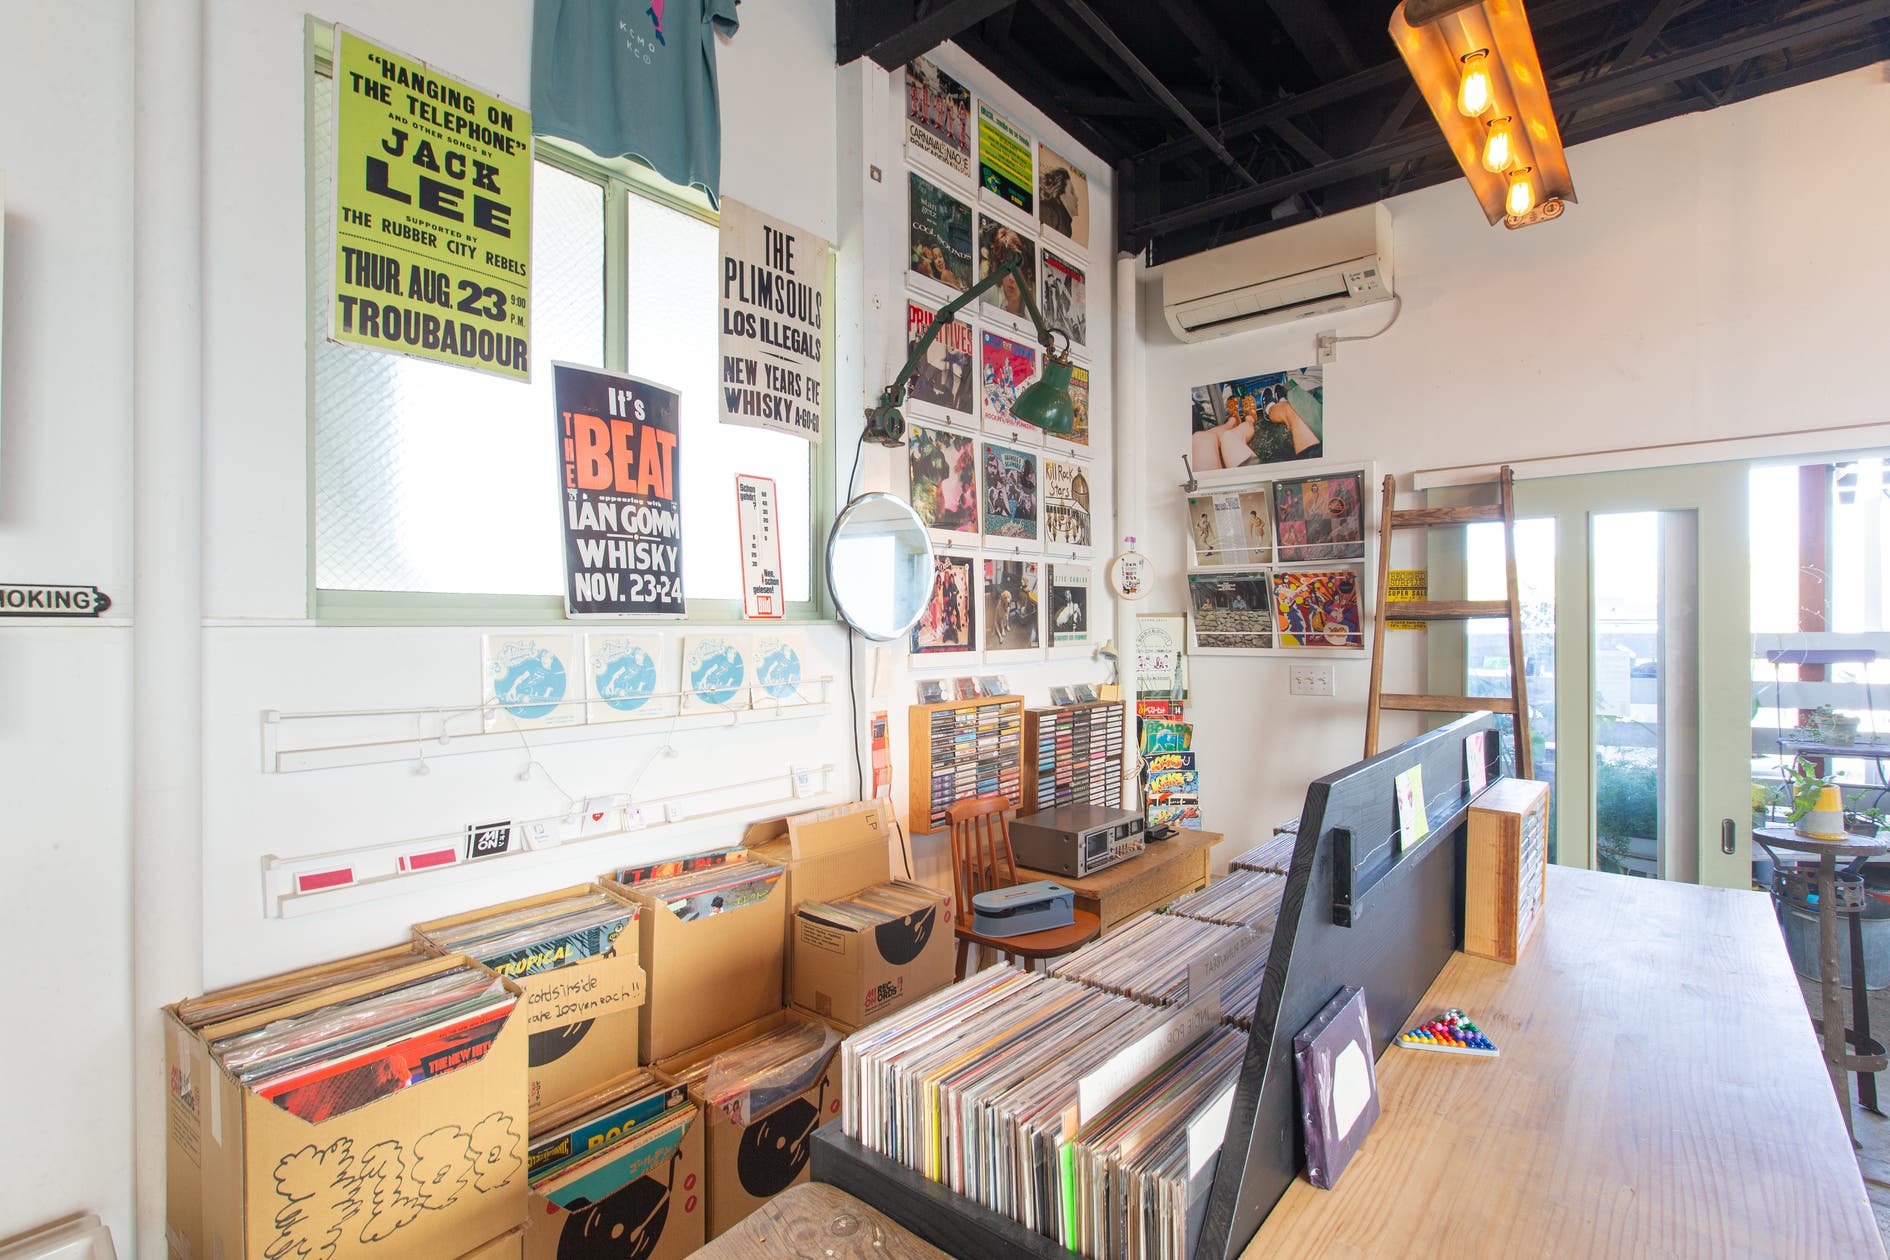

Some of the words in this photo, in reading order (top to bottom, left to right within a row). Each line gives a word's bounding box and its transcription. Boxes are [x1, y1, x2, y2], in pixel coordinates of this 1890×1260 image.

[350, 71, 392, 106] THE
[388, 112, 408, 125] AND
[412, 120, 442, 140] OTHER
[447, 136, 476, 154] SONGS
[481, 150, 493, 159] BY
[488, 106, 513, 132] ON
[382, 128, 500, 194] JACK
[366, 156, 511, 238] LEE
[342, 206, 372, 230] THE
[382, 218, 437, 248] RUBBER
[446, 238, 477, 260] CITY
[486, 252, 527, 278] REBELS
[406, 215, 462, 240] SUPPORTED
[466, 234, 478, 244] BY
[764, 224, 795, 275] THE
[342, 246, 404, 298] THUR.
[408, 265, 453, 310] AUG.
[724, 256, 822, 330] PLIMSOULS
[456, 280, 507, 322] 23
[510, 294, 526, 310] 9:00
[510, 312, 526, 328] P.M.
[338, 294, 528, 372] TROUBADOUR
[724, 308, 756, 340] LOS
[760, 316, 821, 363] ILLEGALS
[724, 355, 758, 386] NEW
[764, 363, 802, 398] YEARS
[724, 386, 793, 424] WHISKY
[562, 412, 576, 488] THE
[574, 413, 676, 500] BEAT
[1048, 481, 1070, 498] Stars
[568, 500, 618, 532] IAN
[620, 504, 680, 540] GOMM
[576, 538, 678, 572] WHISKY
[0, 590, 90, 610] OKING
[574, 572, 626, 602] NOV.
[495, 943, 574, 976] TROPICAL
[429, 1056, 448, 1074] THE
[448, 1047, 471, 1066] NEW
